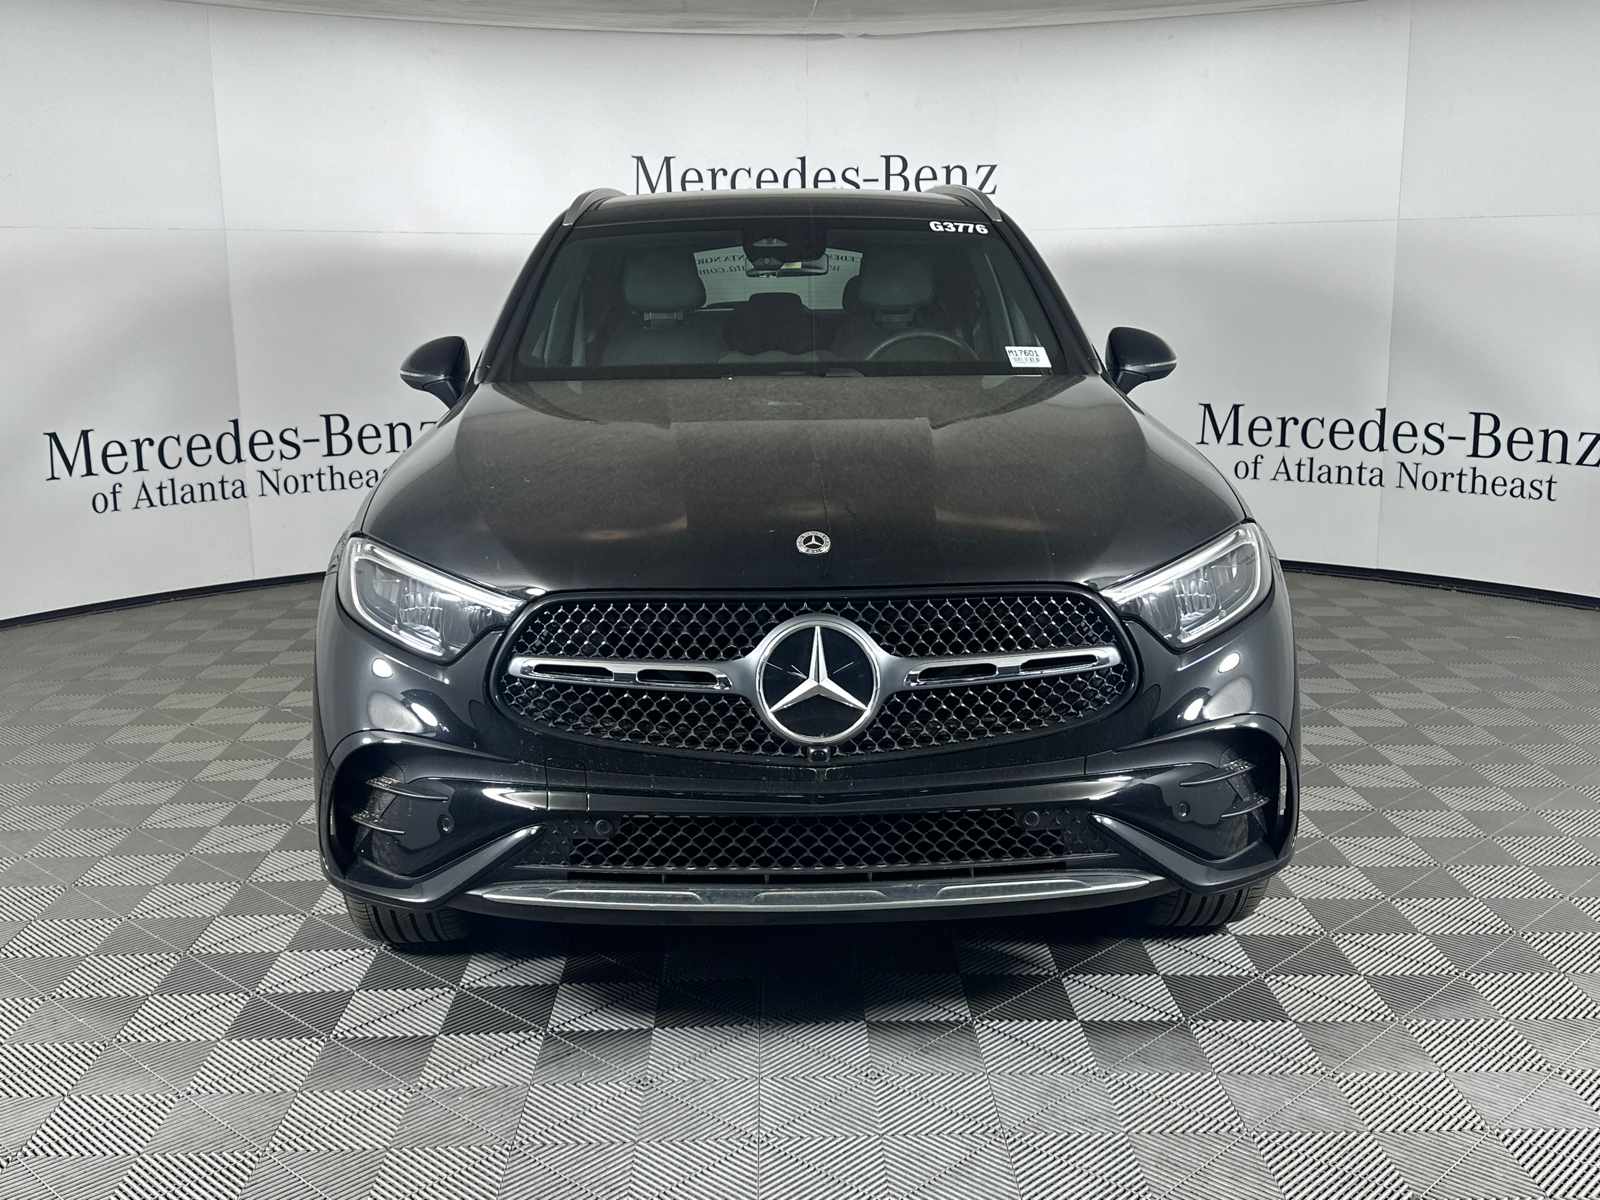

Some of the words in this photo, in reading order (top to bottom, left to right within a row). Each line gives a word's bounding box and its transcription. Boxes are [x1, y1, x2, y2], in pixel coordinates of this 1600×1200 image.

[631, 154, 998, 195] Mercedes-Benz
[929, 220, 989, 235] G3776
[1196, 402, 1600, 468] Mercedes-Benz
[91, 482, 123, 514] of
[131, 477, 247, 510] Atlanta
[256, 465, 388, 498] Northea
[1233, 454, 1264, 480] of
[1270, 455, 1385, 488] Atlanta
[1395, 461, 1558, 502] Northeast
